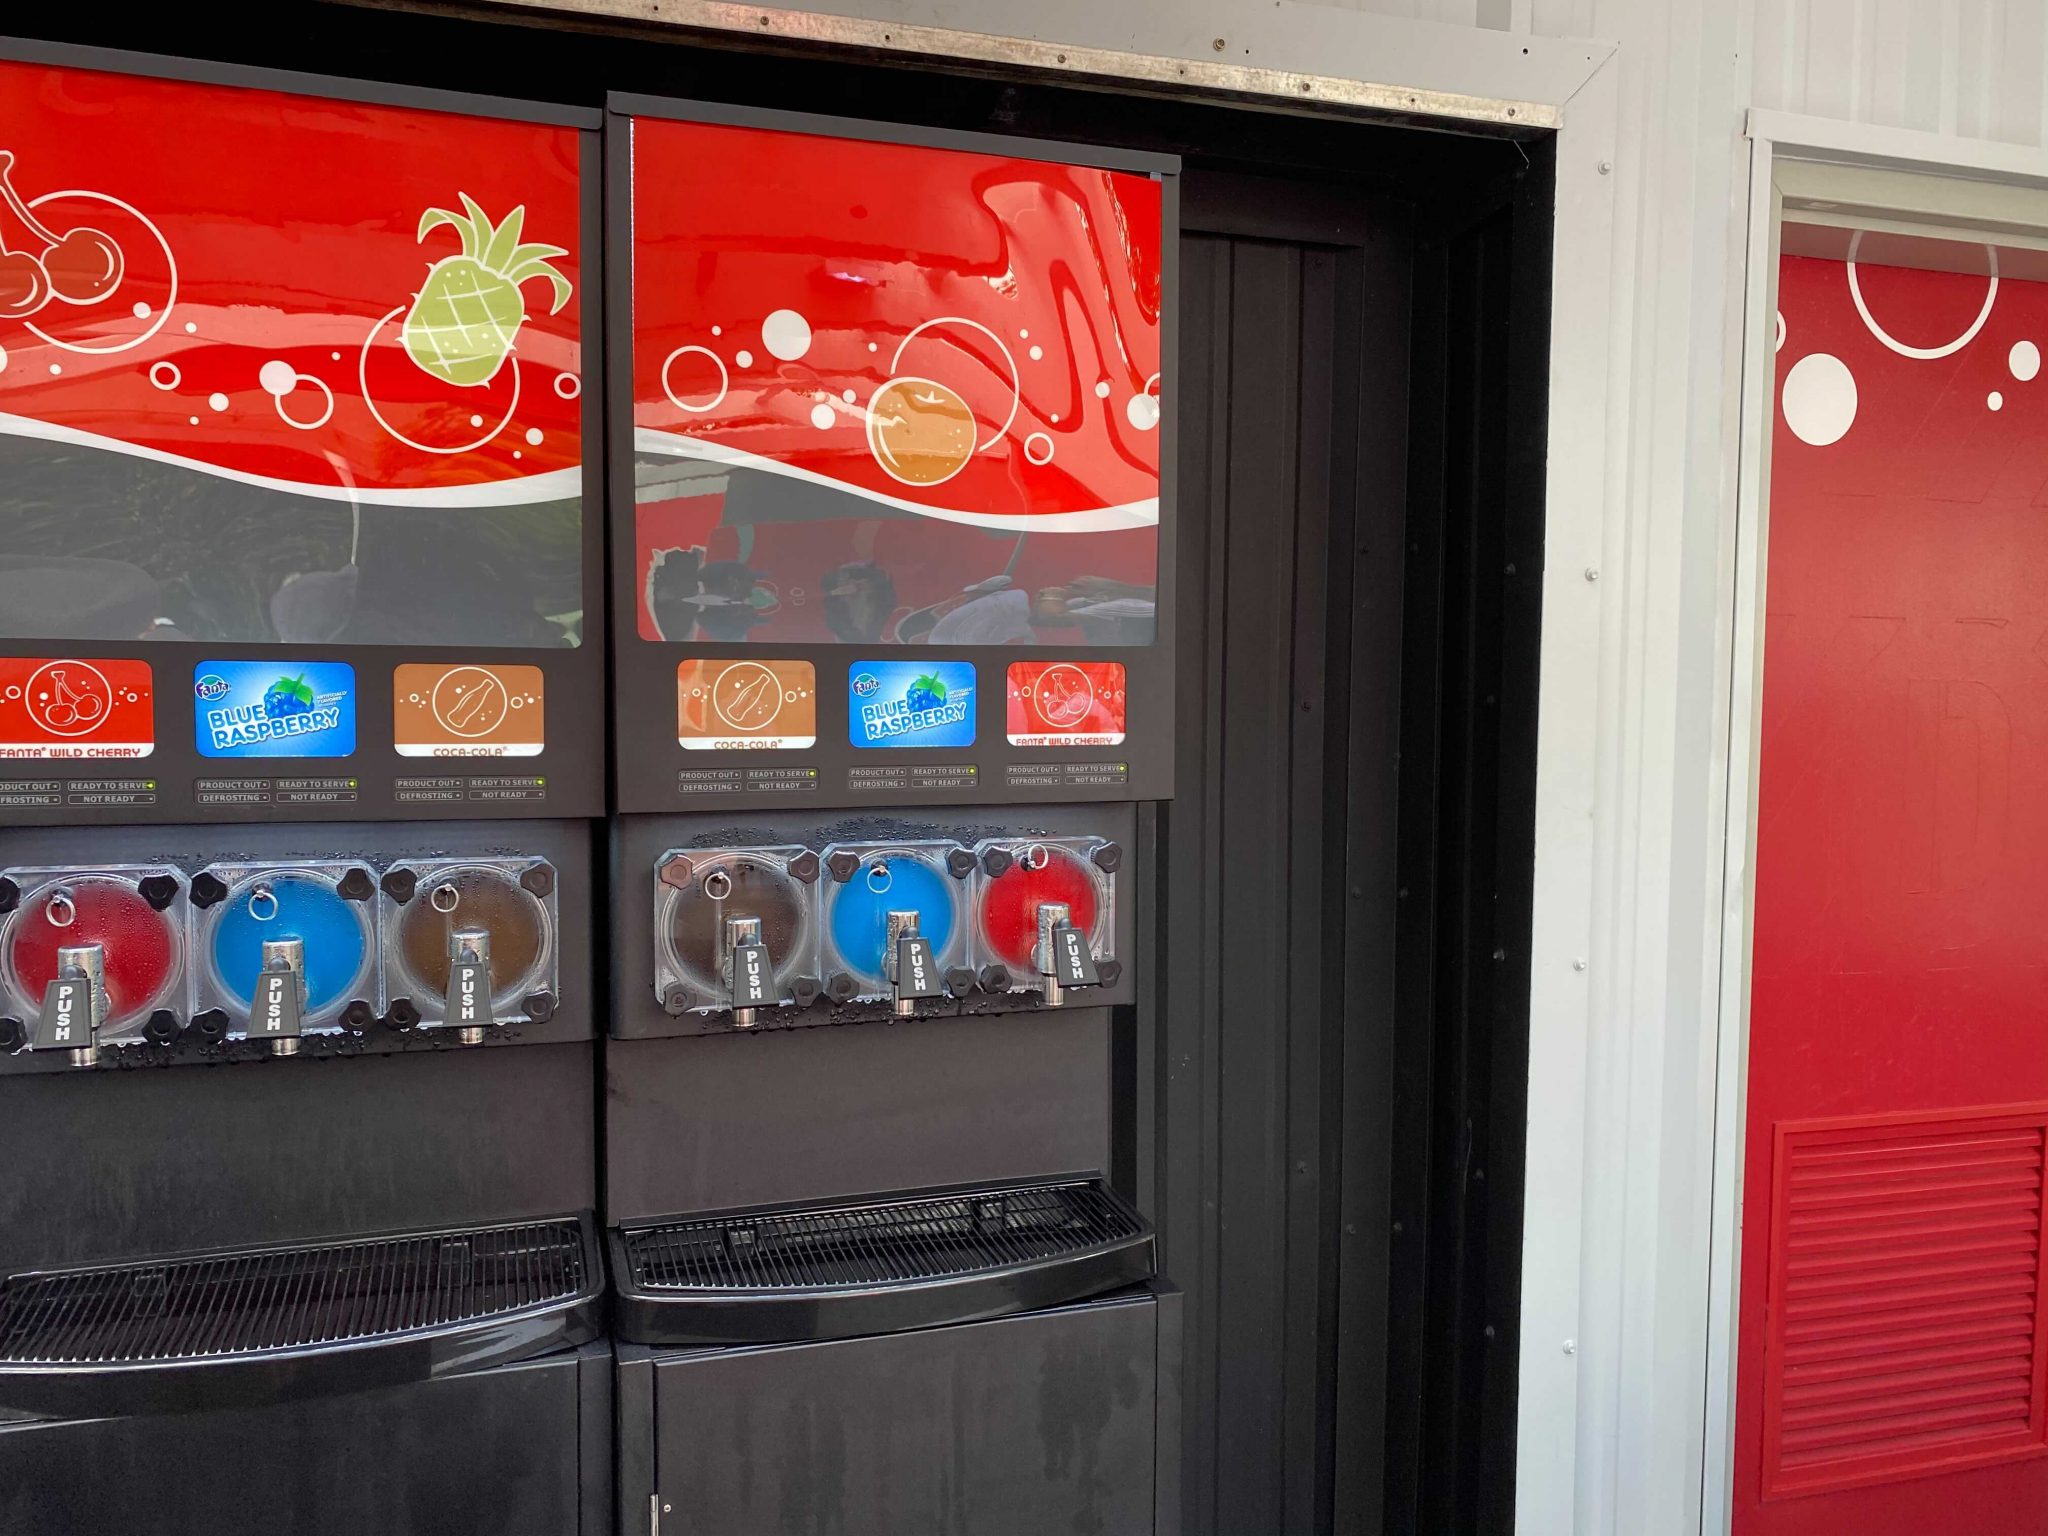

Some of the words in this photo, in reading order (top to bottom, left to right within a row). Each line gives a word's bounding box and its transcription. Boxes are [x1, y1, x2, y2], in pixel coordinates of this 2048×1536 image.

[195, 680, 229, 698] Fanta
[852, 679, 880, 696] Fanta
[861, 699, 910, 724] BLUE
[207, 703, 269, 730] BLUE
[865, 702, 967, 741] RASPBERRY
[212, 707, 340, 749] RASPBERRY
[1048, 737, 1072, 746] WILD
[1073, 737, 1113, 746] CHERRY
[49, 748, 83, 758] WILD
[86, 748, 141, 758] CHERRY
[718, 771, 734, 779] OUT
[775, 770, 785, 778] TO
[786, 770, 810, 778] SERVE
[850, 769, 884, 777] PRODUCT
[913, 768, 937, 776] READY
[200, 781, 242, 789] PRODUCT
[243, 781, 262, 789] OUT
[279, 780, 307, 788] READY
[309, 780, 321, 788] TO
[322, 780, 349, 788] SERVE
[397, 780, 437, 788] PRODUCT
[438, 780, 455, 788] OUT
[471, 779, 498, 787] READY
[852, 780, 899, 788] DEFROSTING
[1010, 777, 1053, 785] DEFROSTING
[70, 782, 102, 790] READY
[104, 782, 117, 790] TO
[118, 782, 147, 790] SERVE
[683, 783, 733, 791] DEFROSTING
[83, 796, 103, 804] NOT
[104, 795, 136, 803] READY
[202, 794, 260, 803] DEFROSTING
[290, 793, 308, 801] NOT
[309, 793, 339, 801] READY
[500, 791, 528, 799] READY
[1066, 933, 1084, 979] PUSH
[910, 943, 927, 991] PUSH
[746, 950, 762, 1000] PUSH
[461, 968, 475, 1020] PUSH
[266, 977, 283, 1031] PUSH
[55, 985, 74, 1041] PUSH
